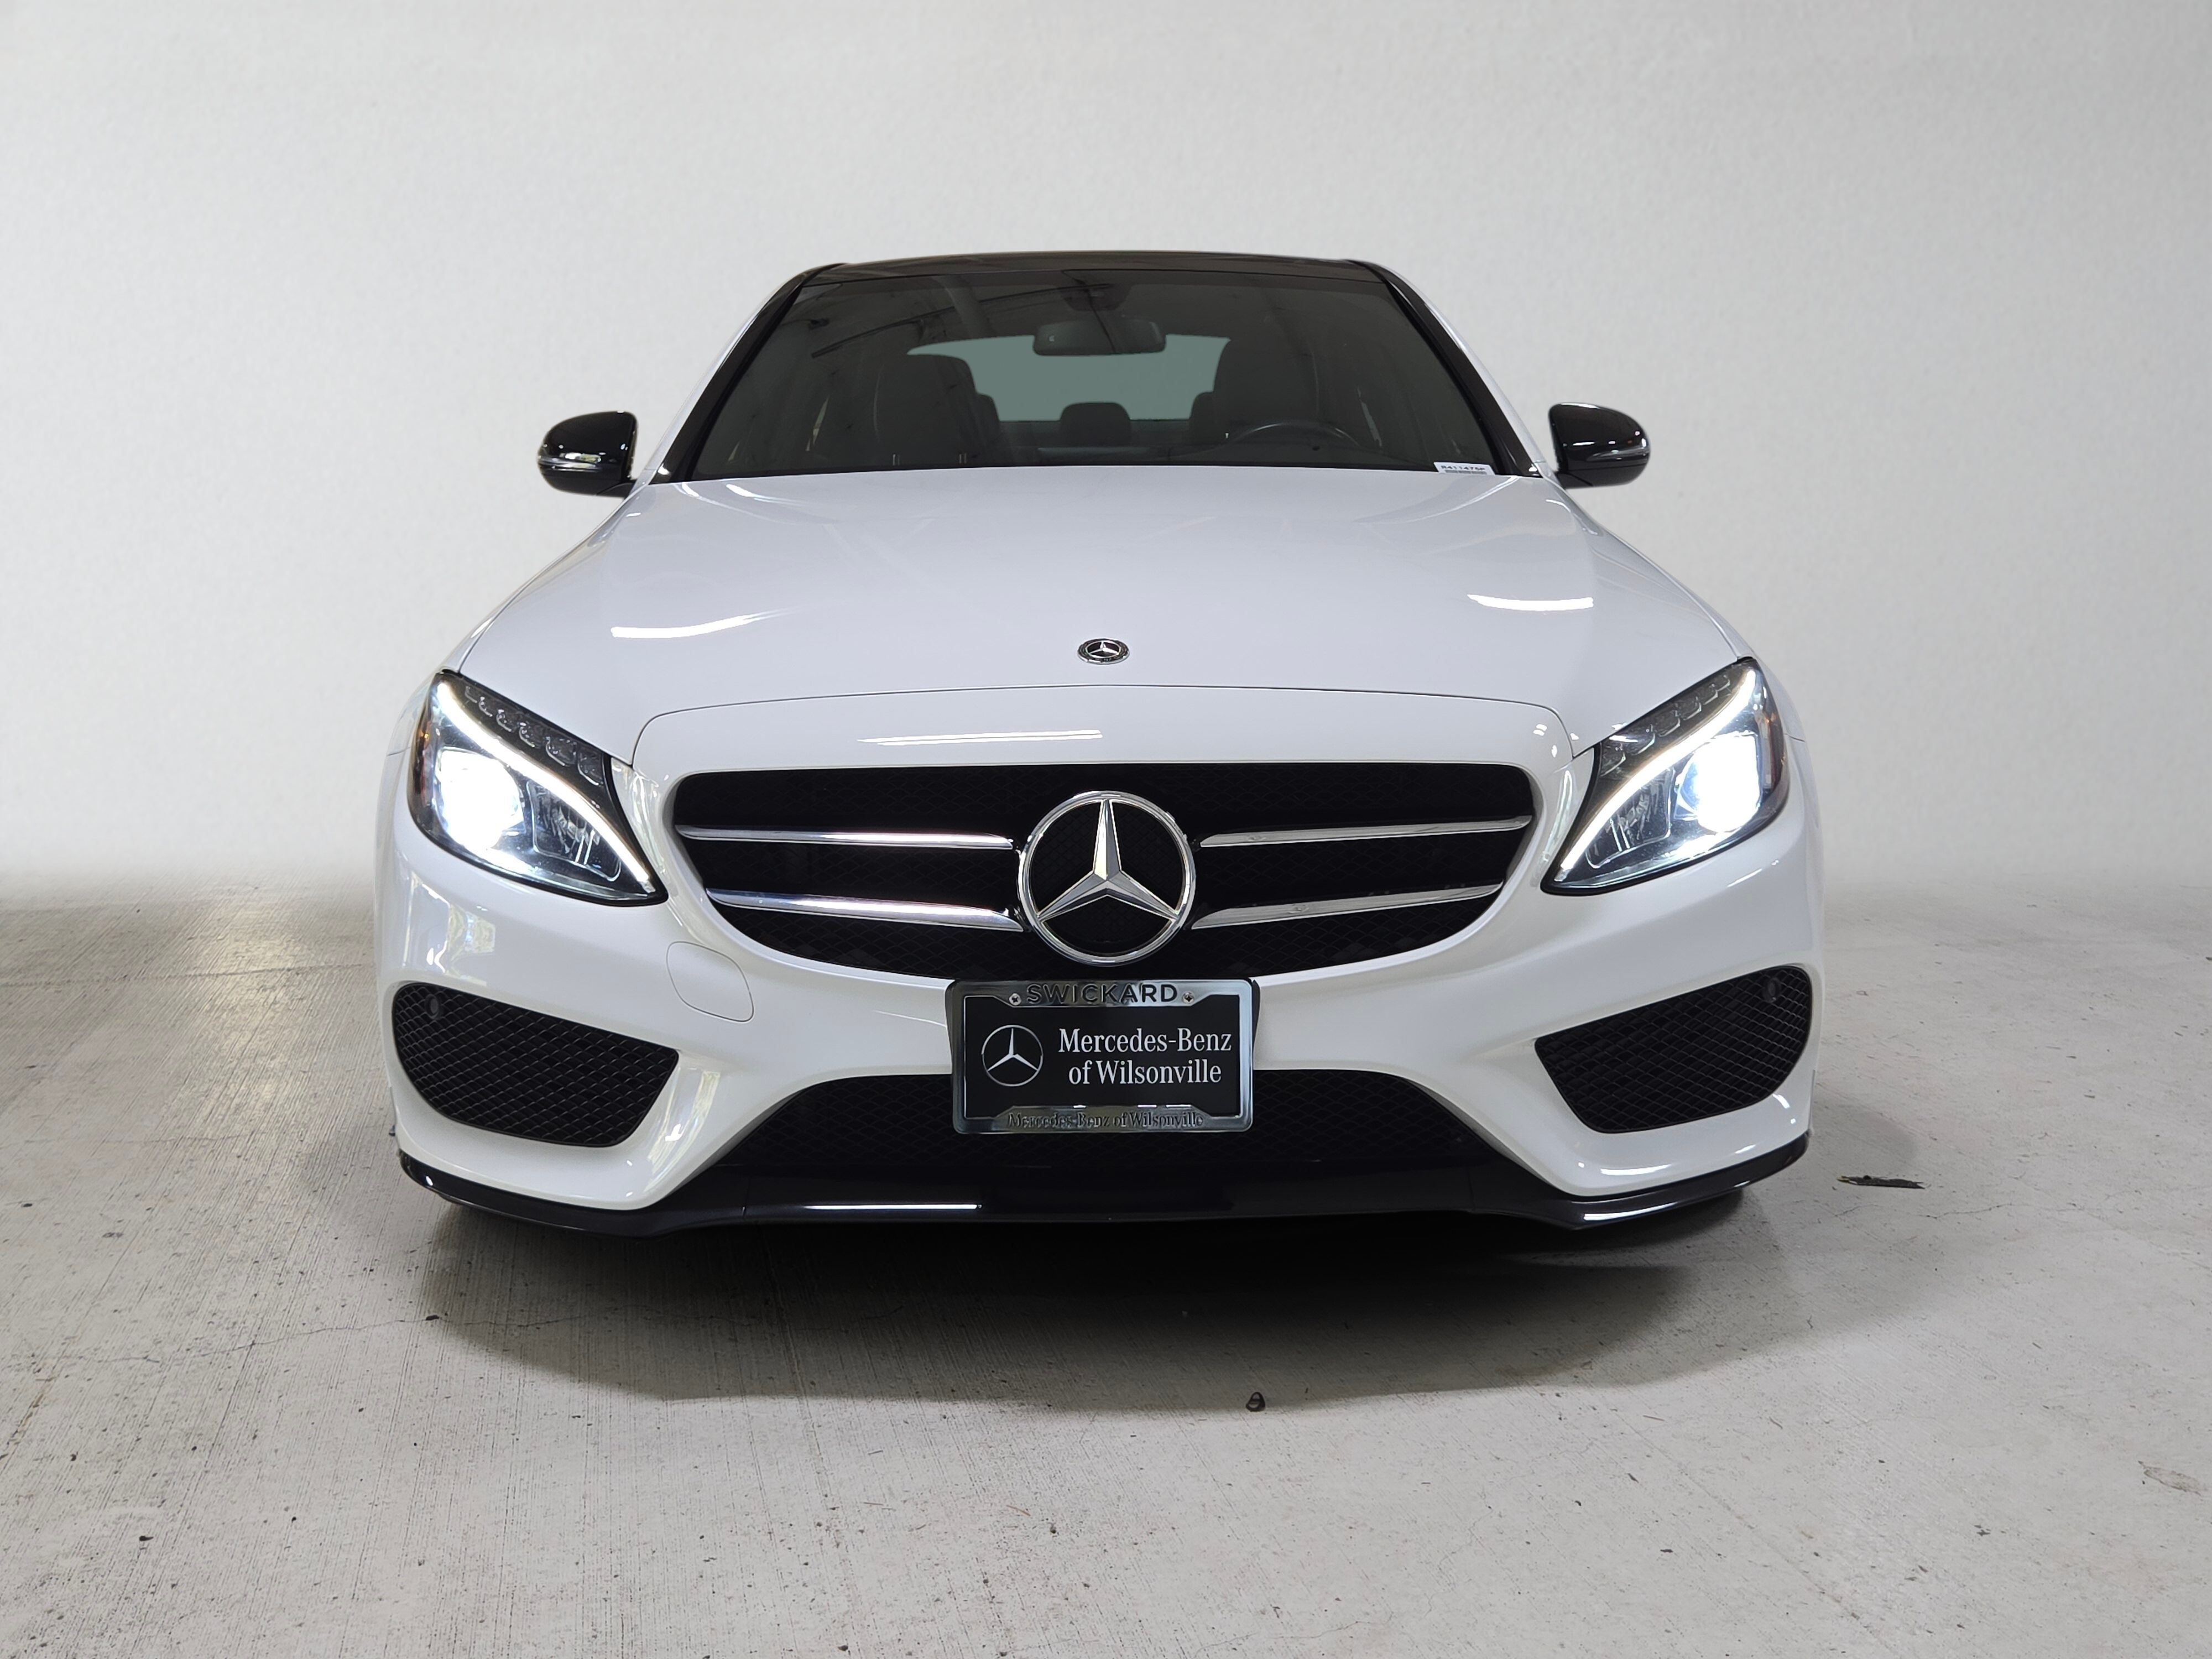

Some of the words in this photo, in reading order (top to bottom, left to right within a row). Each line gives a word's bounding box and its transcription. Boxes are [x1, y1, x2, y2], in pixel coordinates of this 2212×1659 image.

[1026, 984, 1178, 1003] SWICKARD
[1058, 1028, 1232, 1053] Mercedes-Benz
[1068, 1060, 1093, 1084] of
[1097, 1060, 1222, 1084] Wilsonville
[1008, 1112, 1109, 1128] Mercedes-Benz
[1113, 1113, 1128, 1127] of
[1128, 1112, 1203, 1129] Wilsonville
